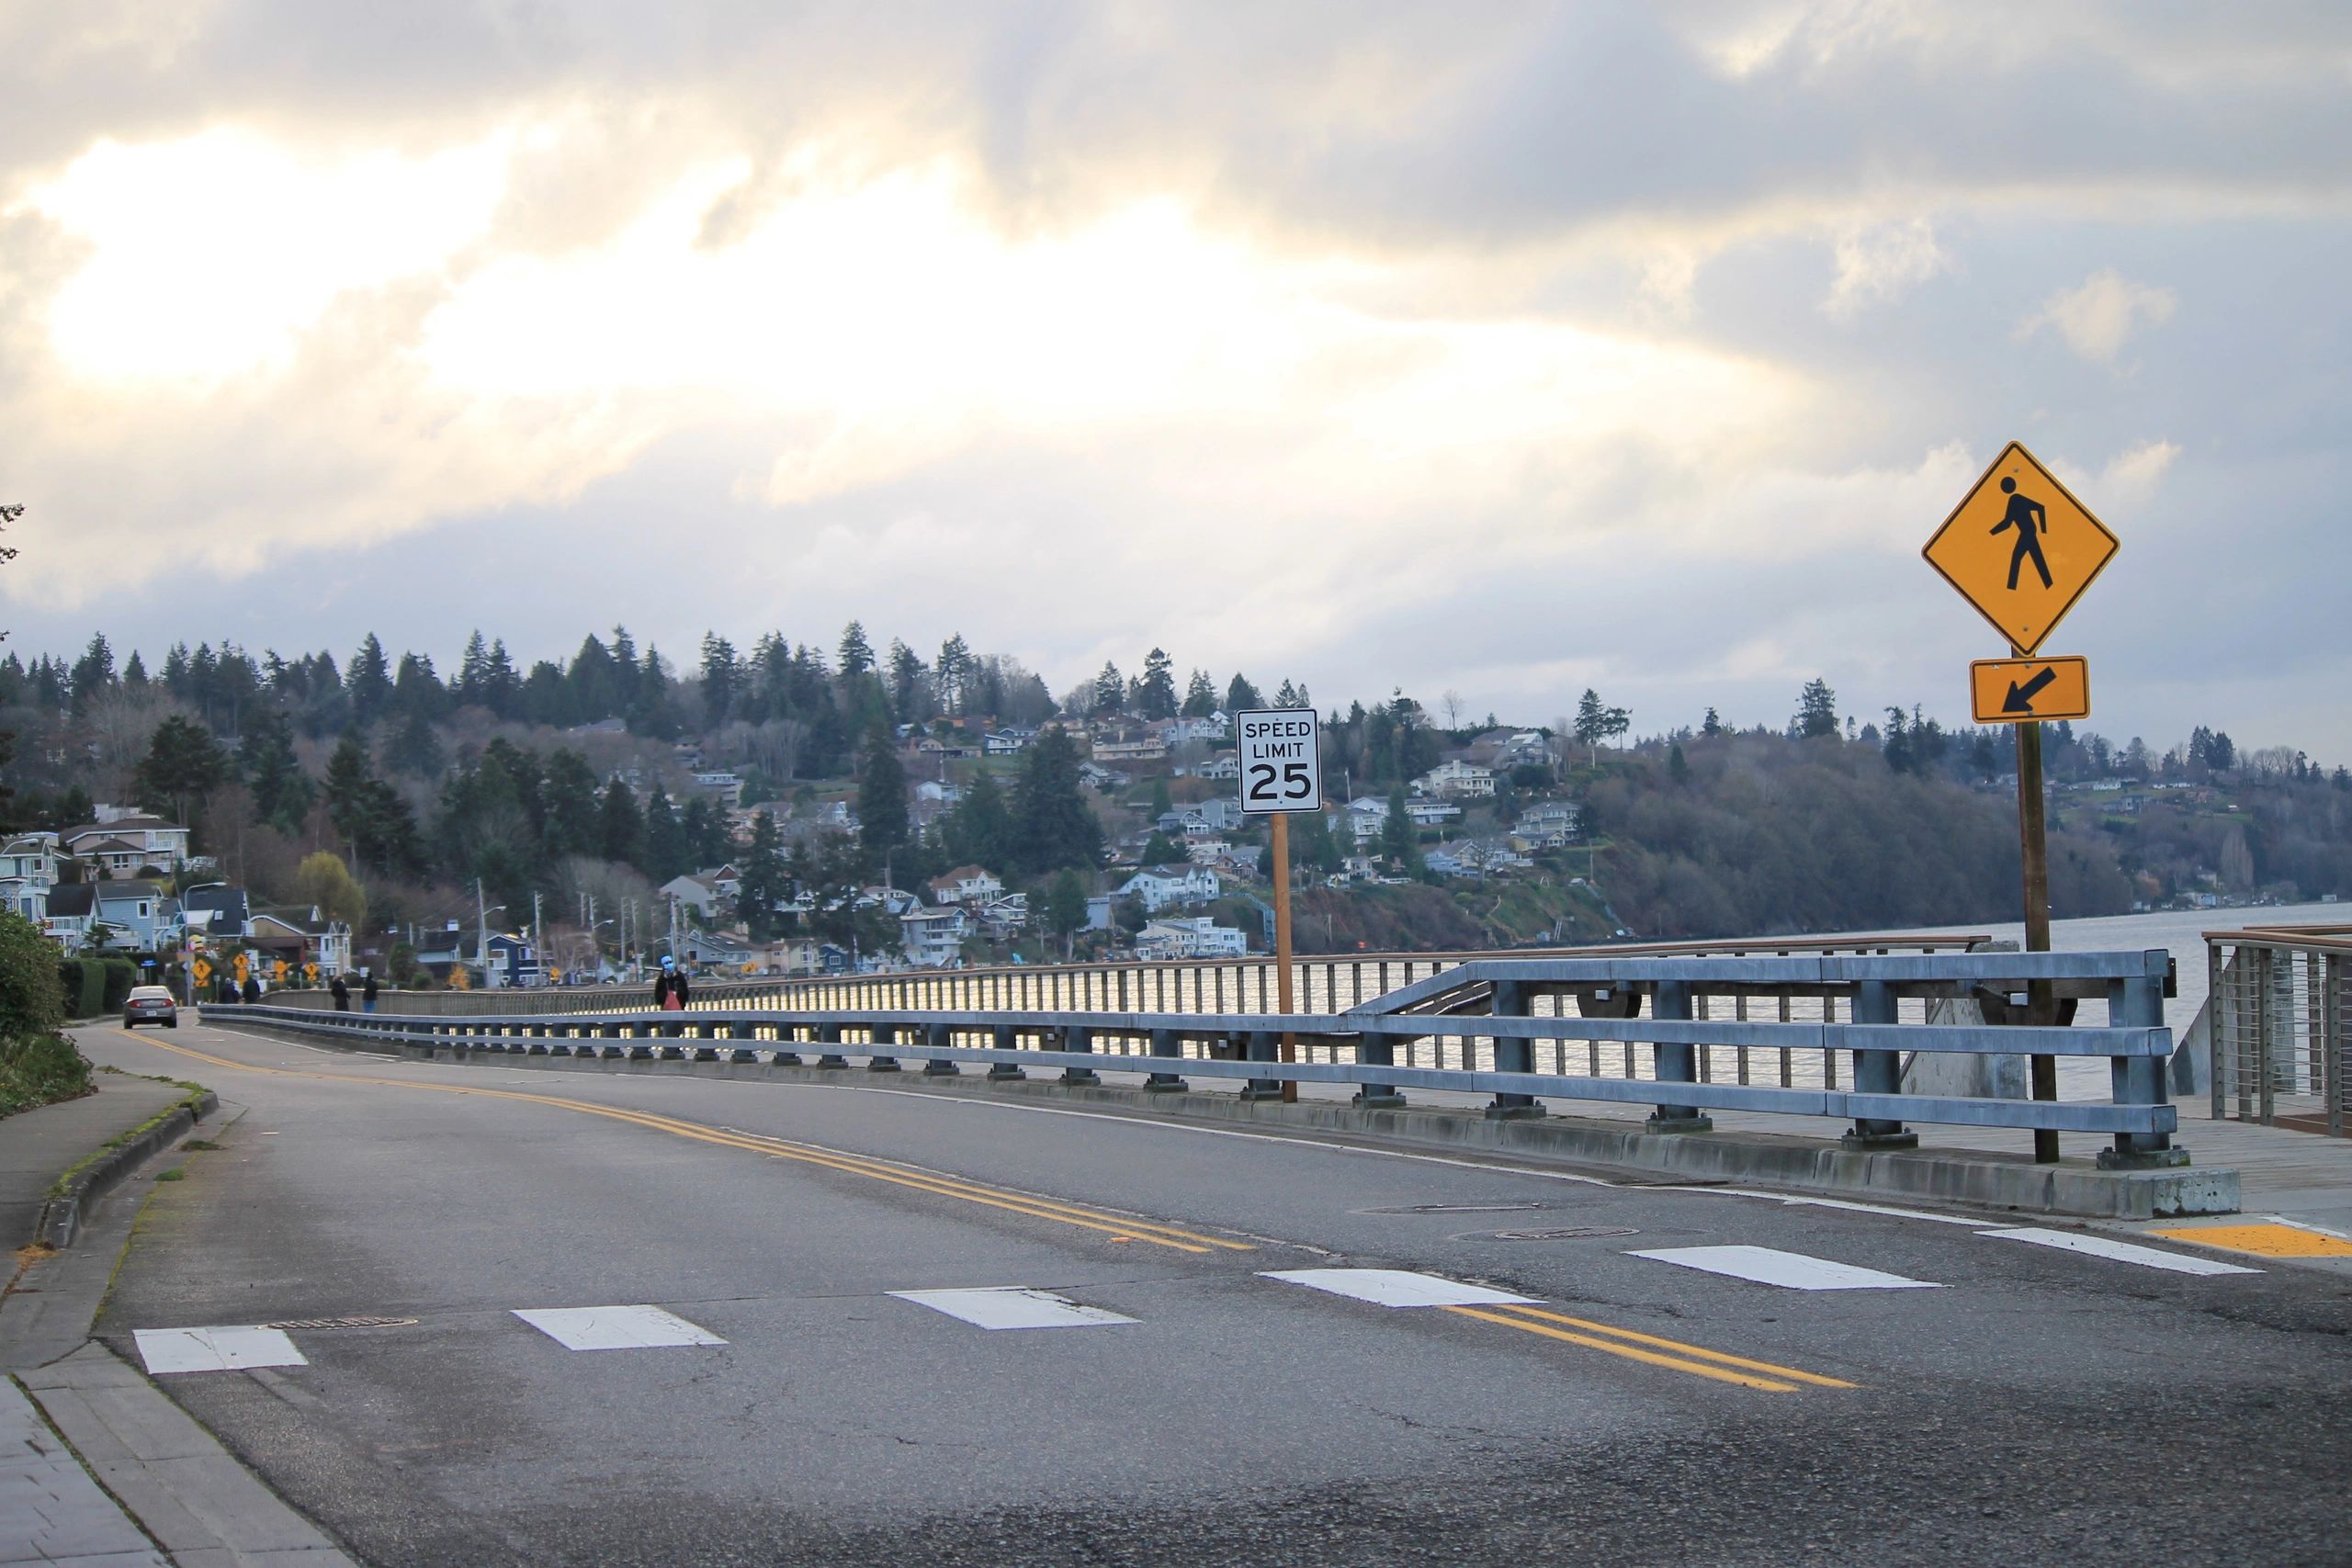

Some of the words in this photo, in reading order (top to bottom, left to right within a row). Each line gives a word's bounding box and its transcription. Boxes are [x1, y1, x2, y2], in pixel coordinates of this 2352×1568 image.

[1246, 722, 1311, 738] SPEED
[1253, 743, 1304, 758] LIMIT
[1250, 763, 1312, 800] 25
